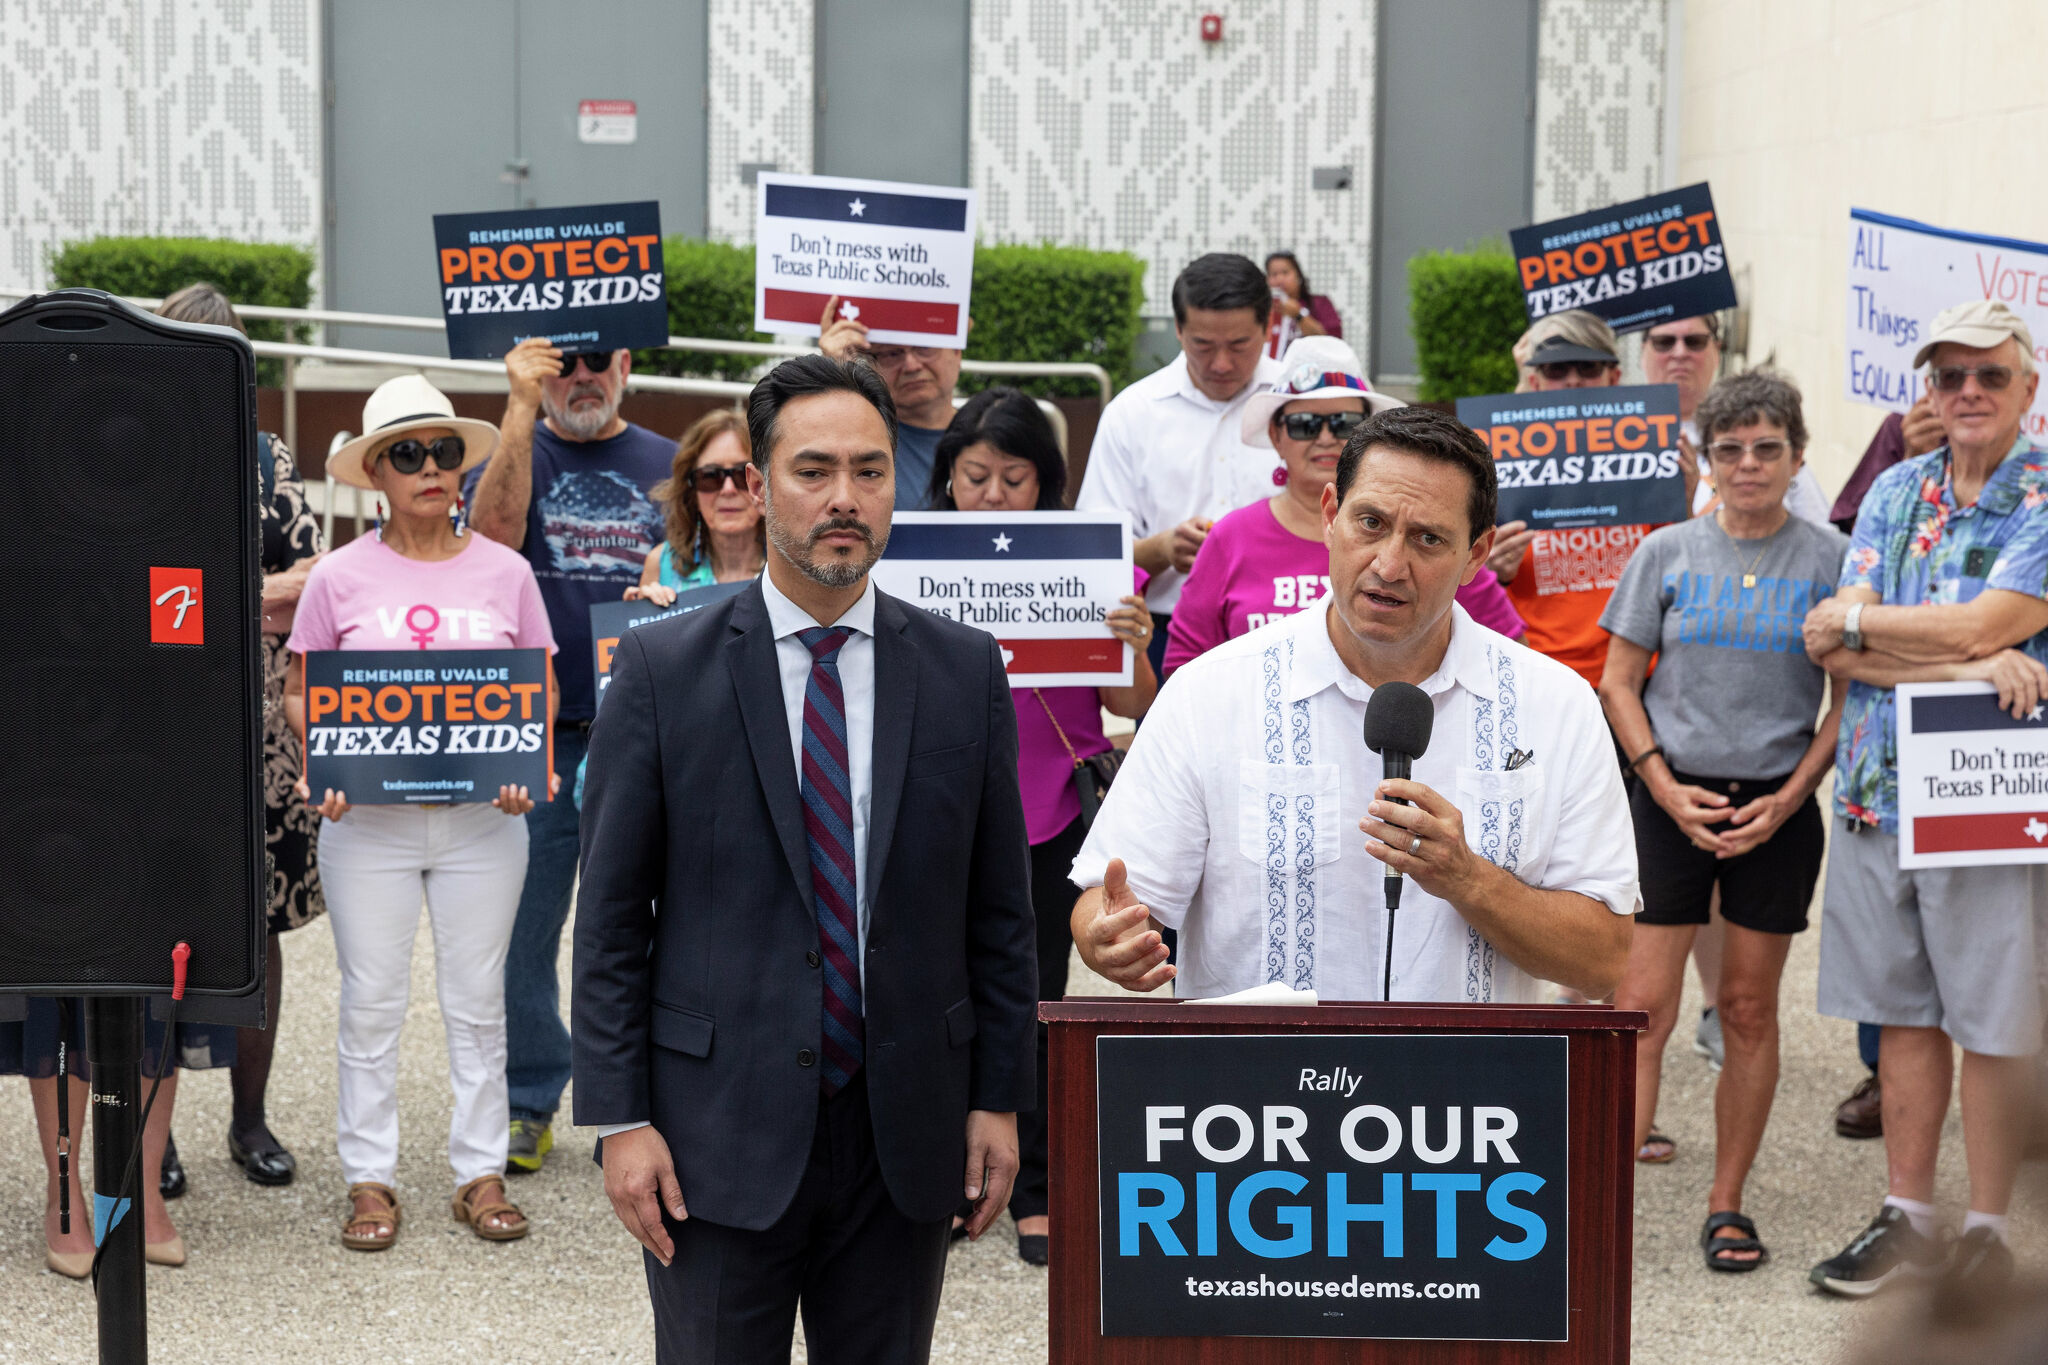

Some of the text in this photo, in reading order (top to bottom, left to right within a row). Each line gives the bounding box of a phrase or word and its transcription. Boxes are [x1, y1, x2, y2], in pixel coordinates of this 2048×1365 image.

[469, 221, 626, 244] REMEMBER UVALDE
[1541, 204, 1684, 251] REMEMBER UVALDE
[440, 234, 659, 284] PROTECT
[790, 232, 928, 264] Don't mess with
[1518, 210, 1715, 291] PROTECT
[1852, 225, 1889, 271] ALL
[772, 254, 950, 289] Texas Public Schools.
[1527, 243, 1725, 319] TEXAS KIDS
[1975, 251, 2048, 307] VOTE
[445, 272, 663, 315] TEXAS KIDS
[1491, 401, 1646, 424] REMEMBER UVALDE
[1494, 449, 1682, 489] EXAS KIDS
[919, 576, 1086, 599] Don't mess with
[959, 602, 1022, 624] Public
[343, 667, 509, 683] REMEMBER UVALDE
[309, 683, 543, 723] PROTECT
[309, 723, 544, 756] TEXAS KIDS
[1950, 747, 2007, 772] Don't
[1924, 776, 1984, 799] Texas
[1298, 1067, 1363, 1097] Rally
[1145, 1104, 1521, 1164] FOR OUR
[1117, 1169, 1549, 1262] RIGHTS
[1185, 1273, 1481, 1300] texashousedems.com
